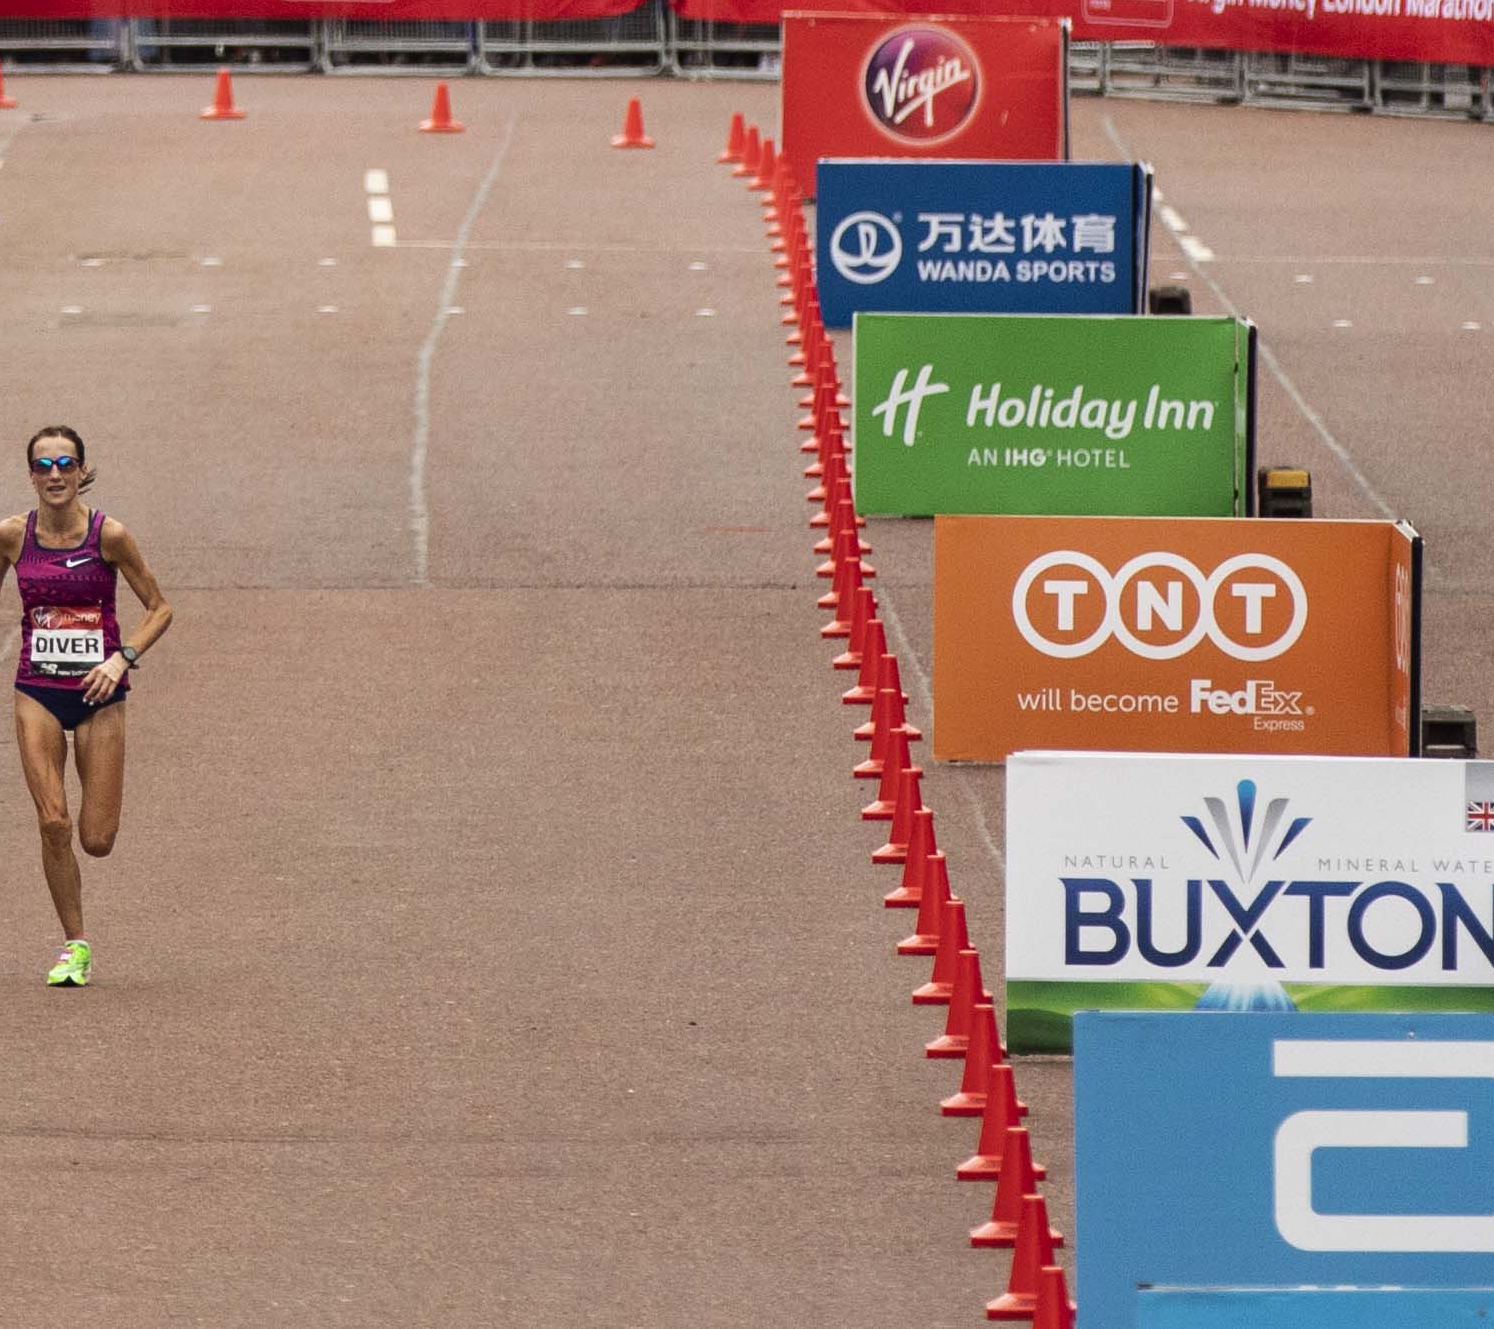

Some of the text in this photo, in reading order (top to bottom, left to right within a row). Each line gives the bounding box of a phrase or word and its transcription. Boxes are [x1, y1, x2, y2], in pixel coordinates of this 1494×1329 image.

[873, 39, 972, 127] Virgin
[917, 212, 1116, 253] 万达体育
[917, 260, 1116, 283] WANDA SPORTS
[965, 382, 1215, 440] Holiday Inn
[967, 448, 998, 467] AN
[1057, 448, 1131, 468] HOTEL
[35, 637, 99, 654] DIVER
[1017, 678, 1304, 716] will become FedEx
[1253, 717, 1305, 732] Express
[1064, 854, 1171, 871] NATURAL
[1317, 856, 1420, 873] MINERAL
